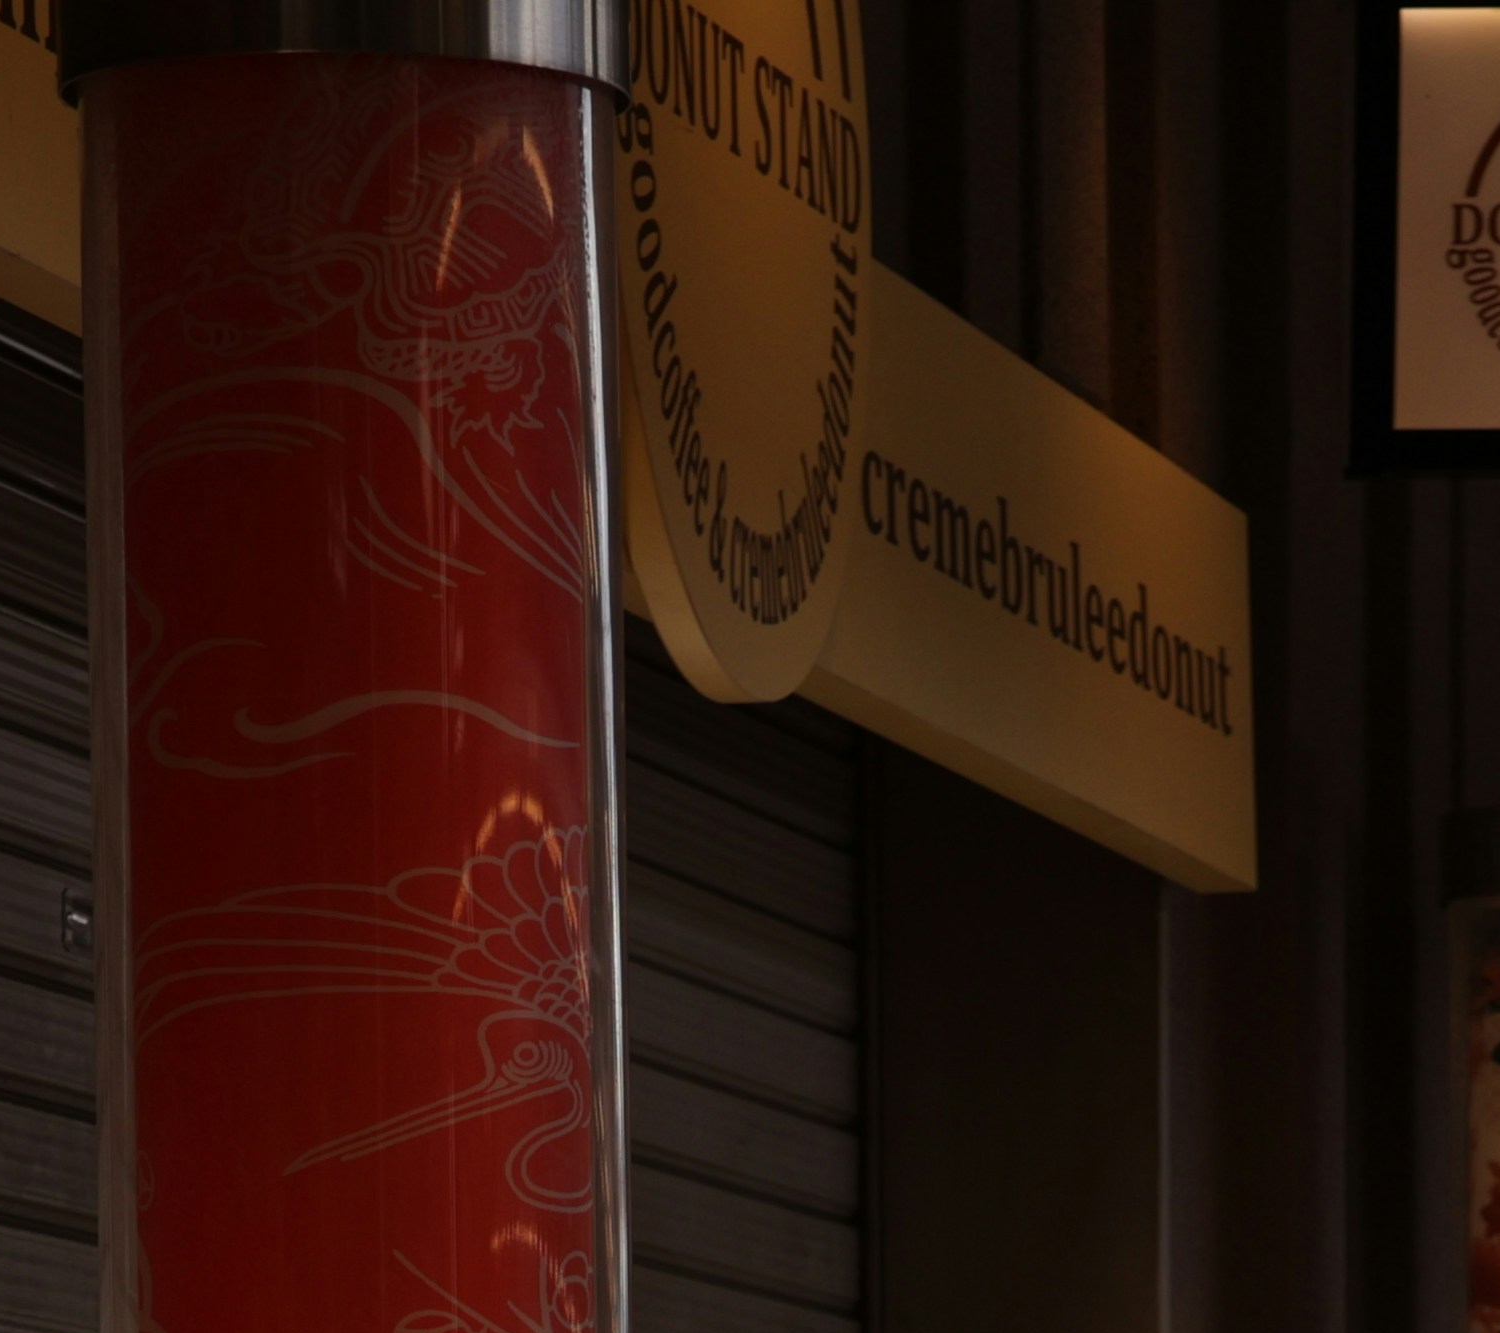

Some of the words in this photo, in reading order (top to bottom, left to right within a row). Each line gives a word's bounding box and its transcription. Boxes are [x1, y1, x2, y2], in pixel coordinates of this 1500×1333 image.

[755, 55, 861, 235] STAND
[617, 103, 708, 536] goodcoffee
[709, 460, 727, 583] &
[861, 450, 1234, 736] cremebruleedonut
